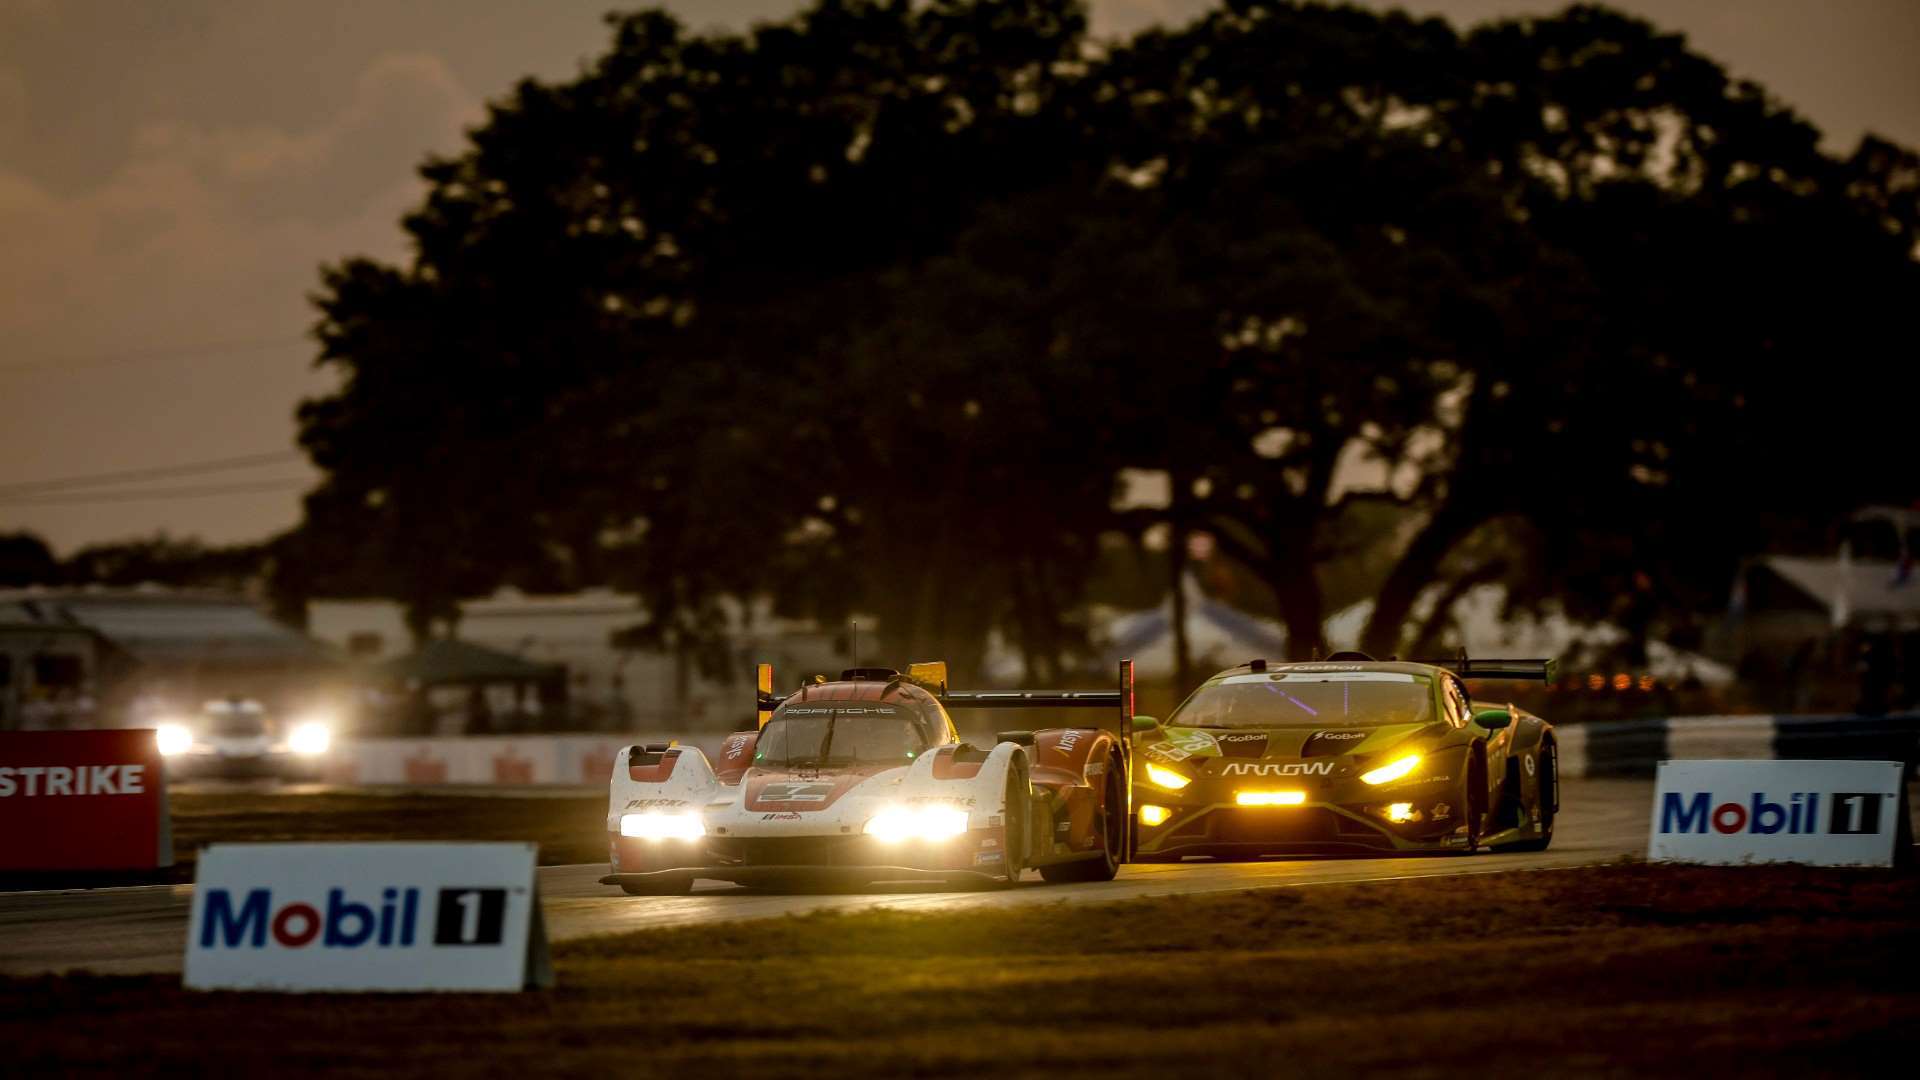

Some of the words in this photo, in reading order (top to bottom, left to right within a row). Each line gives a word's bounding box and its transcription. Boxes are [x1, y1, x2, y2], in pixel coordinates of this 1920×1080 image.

[1227, 734, 1267, 742] GoBolt
[0, 764, 145, 797] STRIKE
[1222, 762, 1335, 776] ARROW
[1658, 792, 1820, 834] Mobil
[200, 888, 419, 947] Mobil
